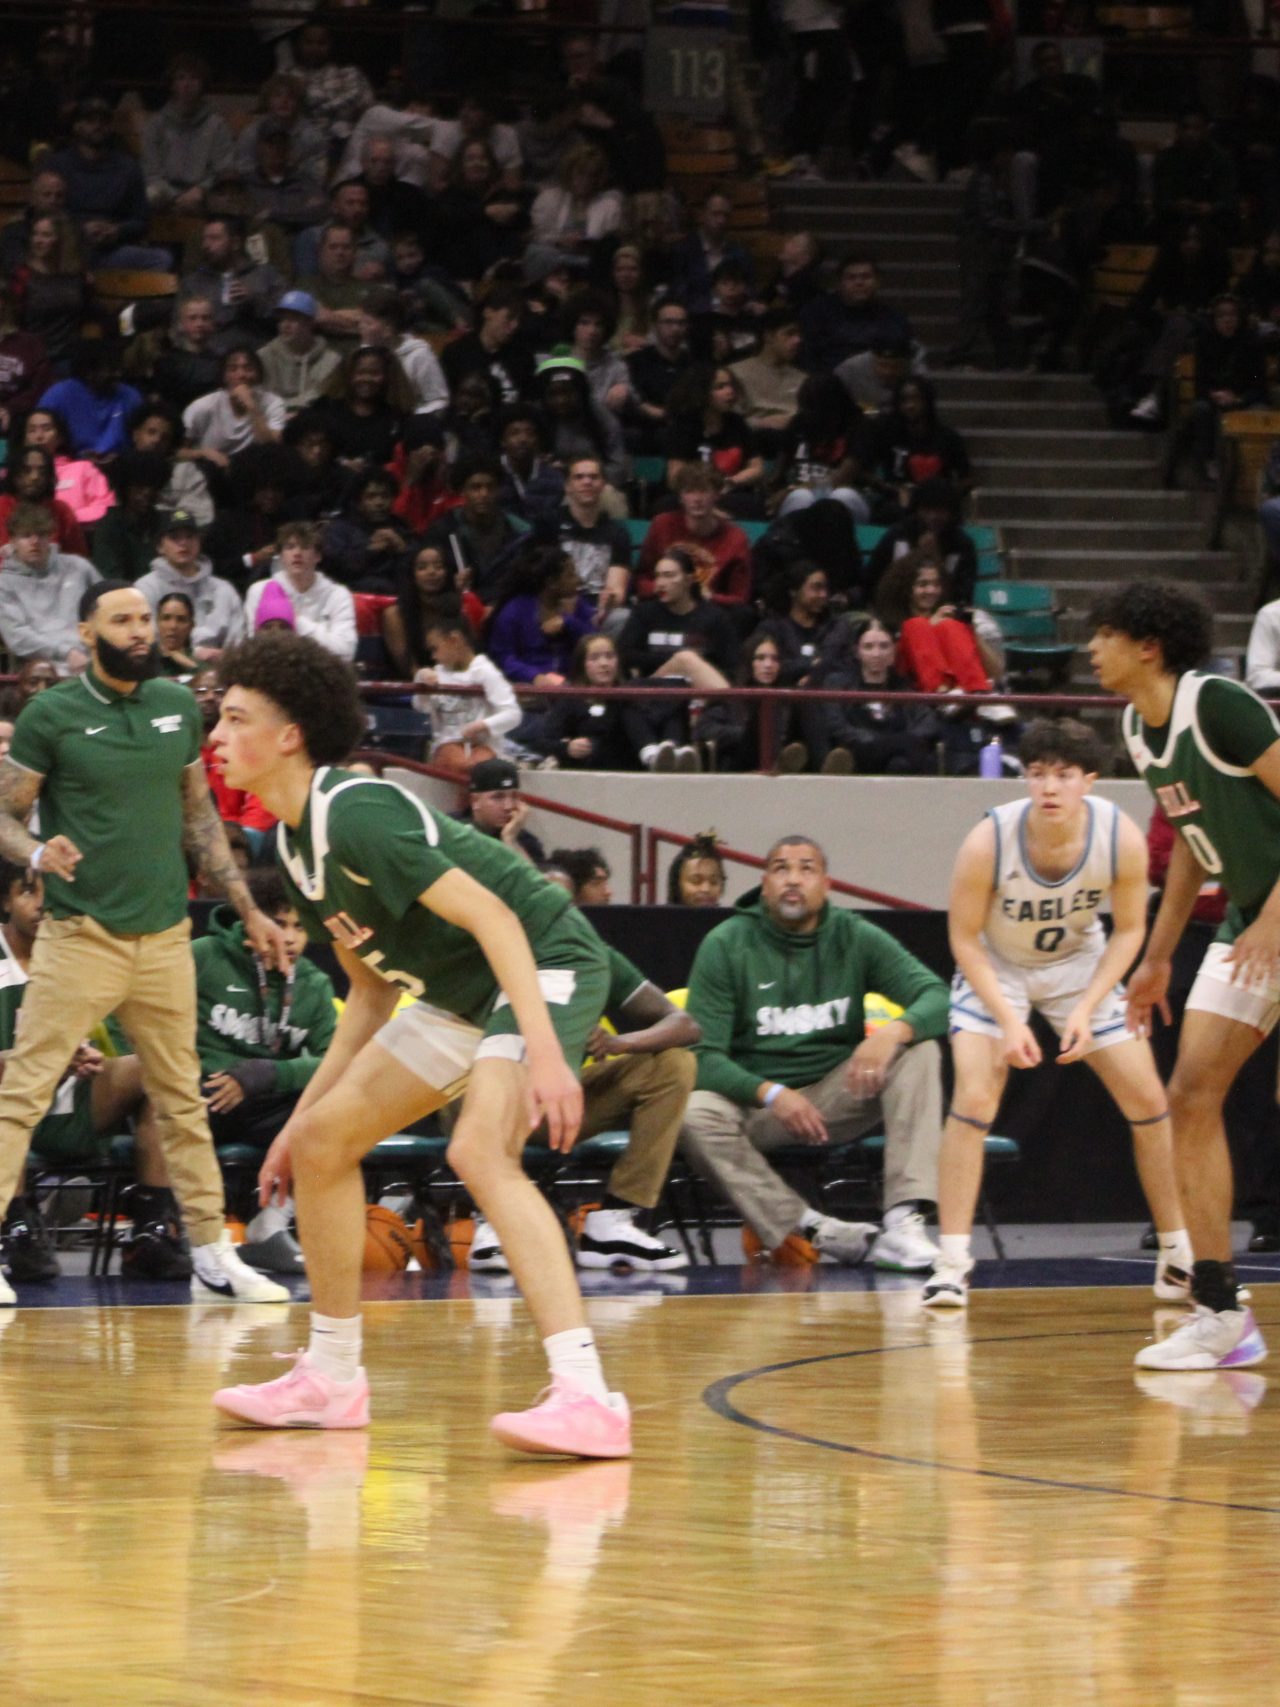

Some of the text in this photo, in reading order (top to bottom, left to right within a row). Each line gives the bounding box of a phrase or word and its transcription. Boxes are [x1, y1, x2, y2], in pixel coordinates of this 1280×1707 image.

[670, 49, 726, 98] 113
[1002, 888, 1103, 922] EAGLES
[1034, 926, 1066, 953] 0
